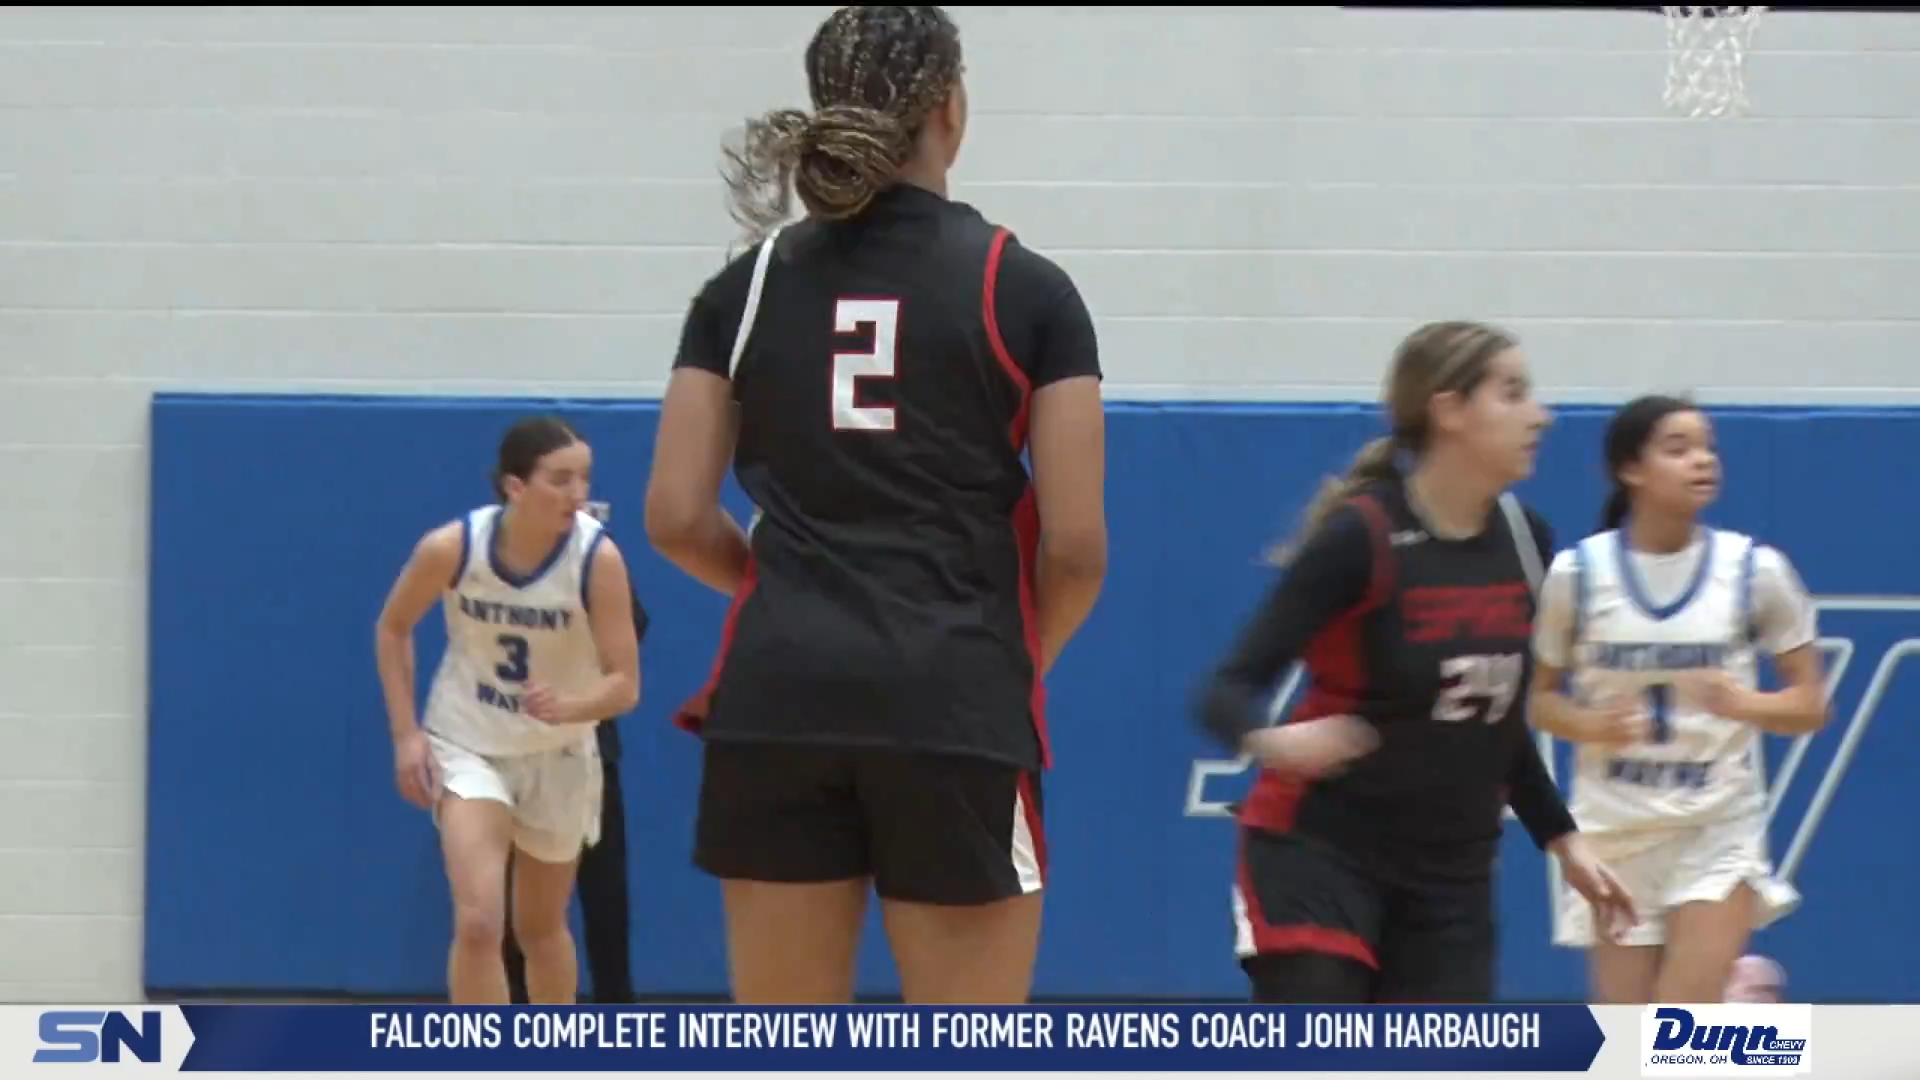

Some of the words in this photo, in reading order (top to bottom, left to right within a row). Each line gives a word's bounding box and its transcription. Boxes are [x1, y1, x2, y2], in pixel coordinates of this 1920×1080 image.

[830, 295, 903, 430] 2
[459, 594, 573, 630] ANTHONY
[495, 633, 529, 682] 3
[1431, 652, 1522, 724] 24
